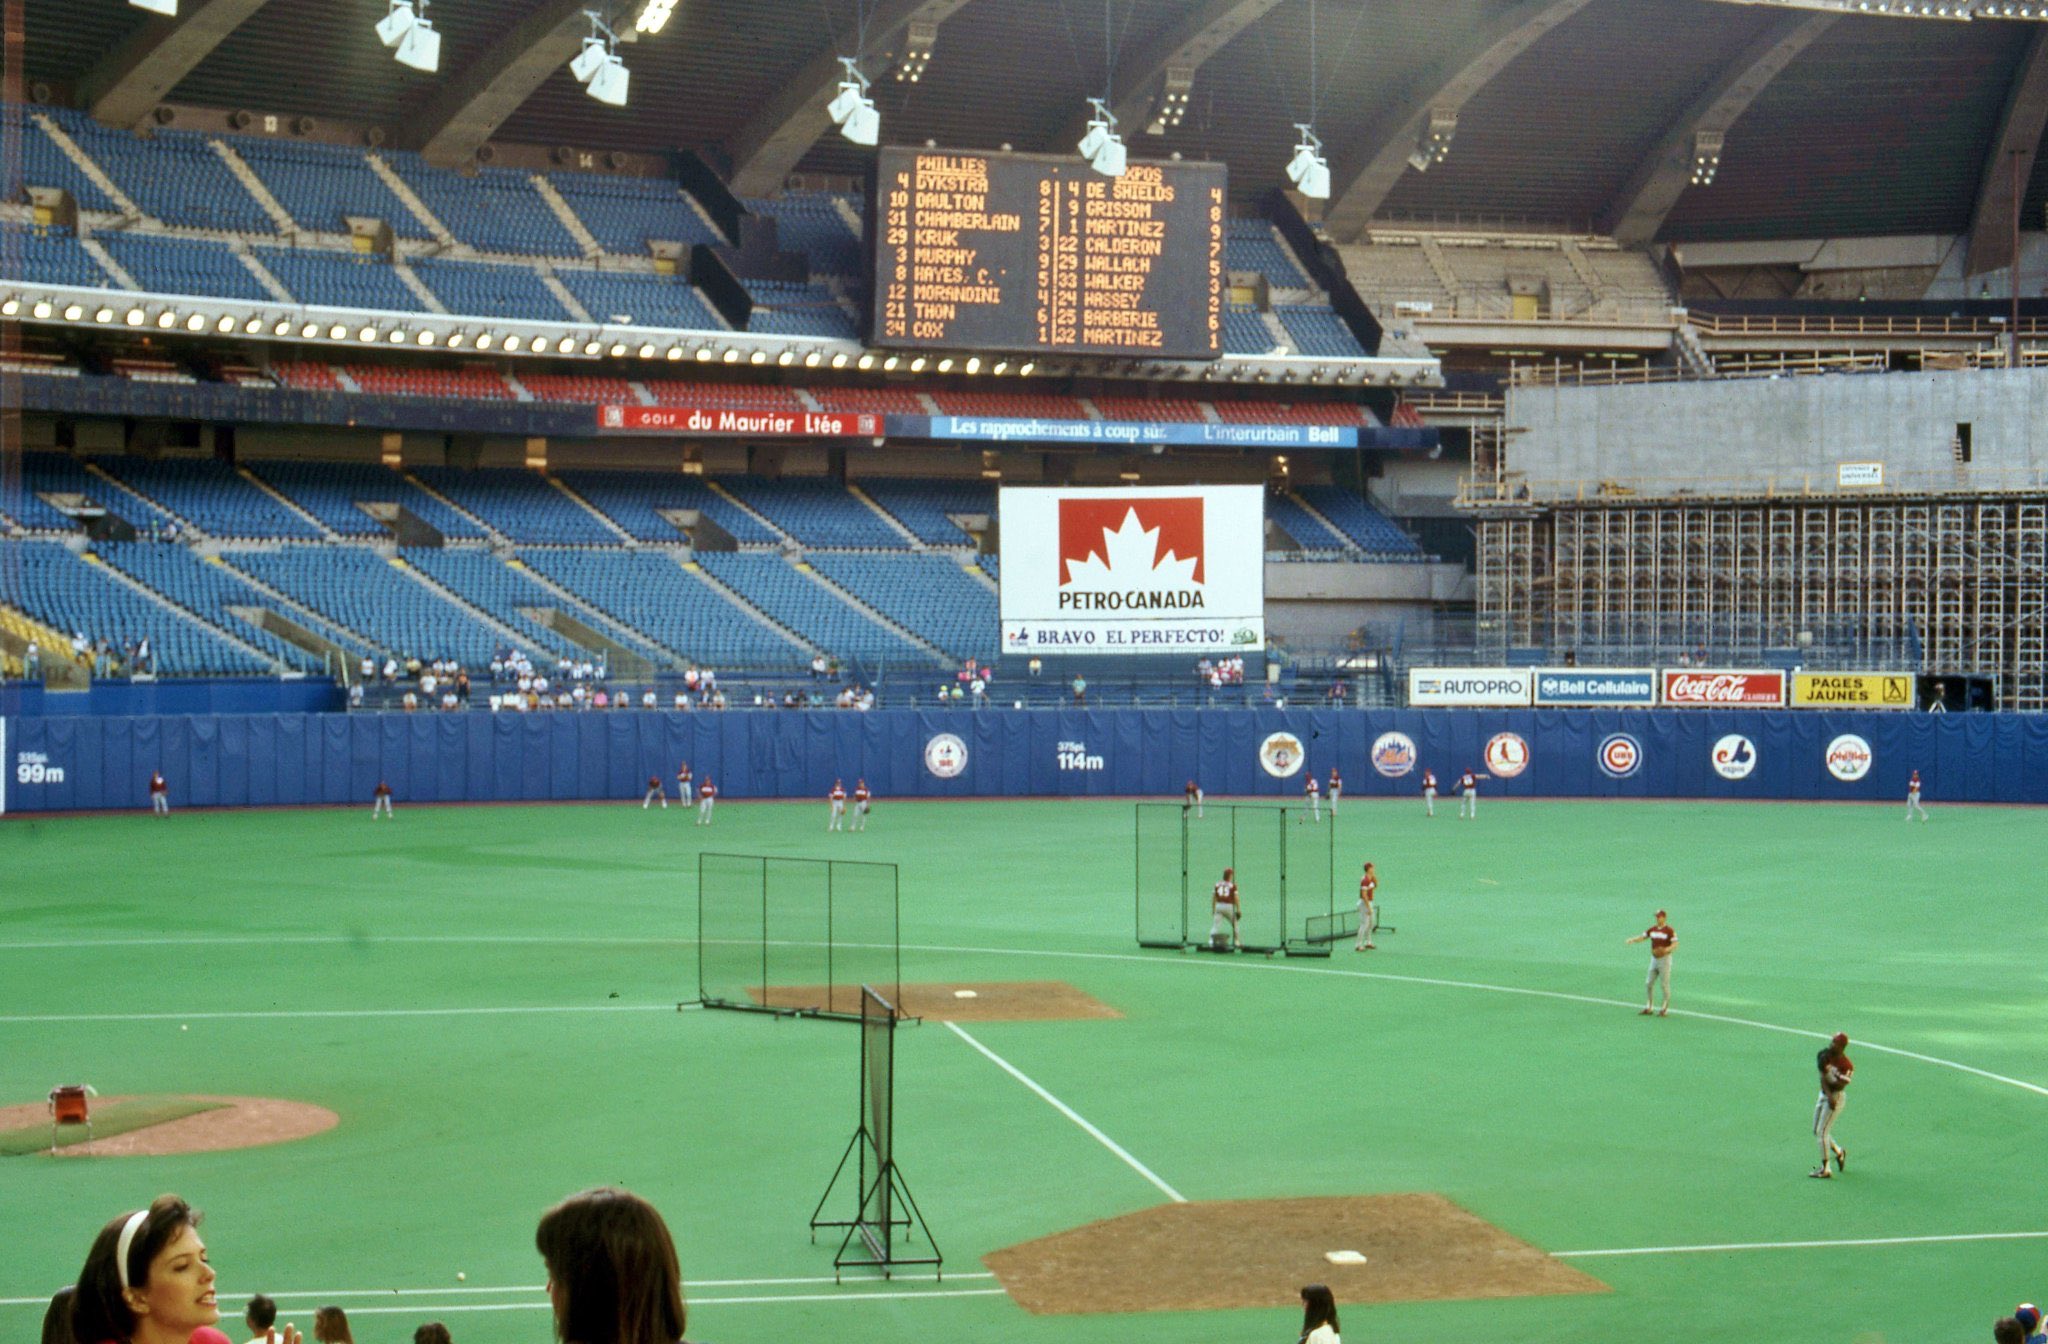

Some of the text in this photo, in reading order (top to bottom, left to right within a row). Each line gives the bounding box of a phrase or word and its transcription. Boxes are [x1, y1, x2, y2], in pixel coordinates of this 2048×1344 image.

[917, 156, 986, 173] PHILLIES
[898, 173, 1050, 195] 4 DYKSTRA 8
[1068, 181, 1222, 204] 4 DE SHIELDS 4
[890, 191, 1050, 214] 10 DAULTON 2
[1068, 200, 1221, 221] 9 GRISSOM 8
[888, 210, 1050, 232] 31 CHAMBERLAIN 7
[1070, 219, 1221, 239] 1 MARTINEZ 9
[888, 229, 1049, 250] 29 KRUK 3
[1059, 237, 1220, 257] 22 CALDERON 7
[897, 248, 1049, 269] 3 MURPHY 9
[1059, 255, 1220, 276] 29 WALLACH 5
[896, 266, 906, 281] 8
[1038, 271, 1048, 286] 5
[1059, 273, 1220, 294] 33 WALKER 3
[888, 284, 1048, 305] 12 MORANDINI 4
[1058, 291, 1077, 306] 24
[886, 303, 1048, 323] 21 THON 6
[1057, 309, 1219, 329] 25 BARBERIE 6
[886, 321, 1047, 342] 34 COX 1
[1057, 328, 1218, 348] 32 MARTINEZ 1
[641, 411, 842, 434] GOLF du Maurier Ltée
[951, 416, 976, 435] Les
[980, 419, 1090, 440] rapprochements
[1093, 422, 1102, 437] à
[1105, 424, 1139, 443] coup
[1308, 426, 1339, 443] Bell
[1037, 629, 1224, 644] BRAVO EL PERFECTO!
[1444, 680, 1522, 694] AUTOPRO
[1560, 681, 1649, 695] Bell Cellulaire
[1811, 678, 1864, 688] PAGES
[1807, 690, 1868, 700] JAUNES
